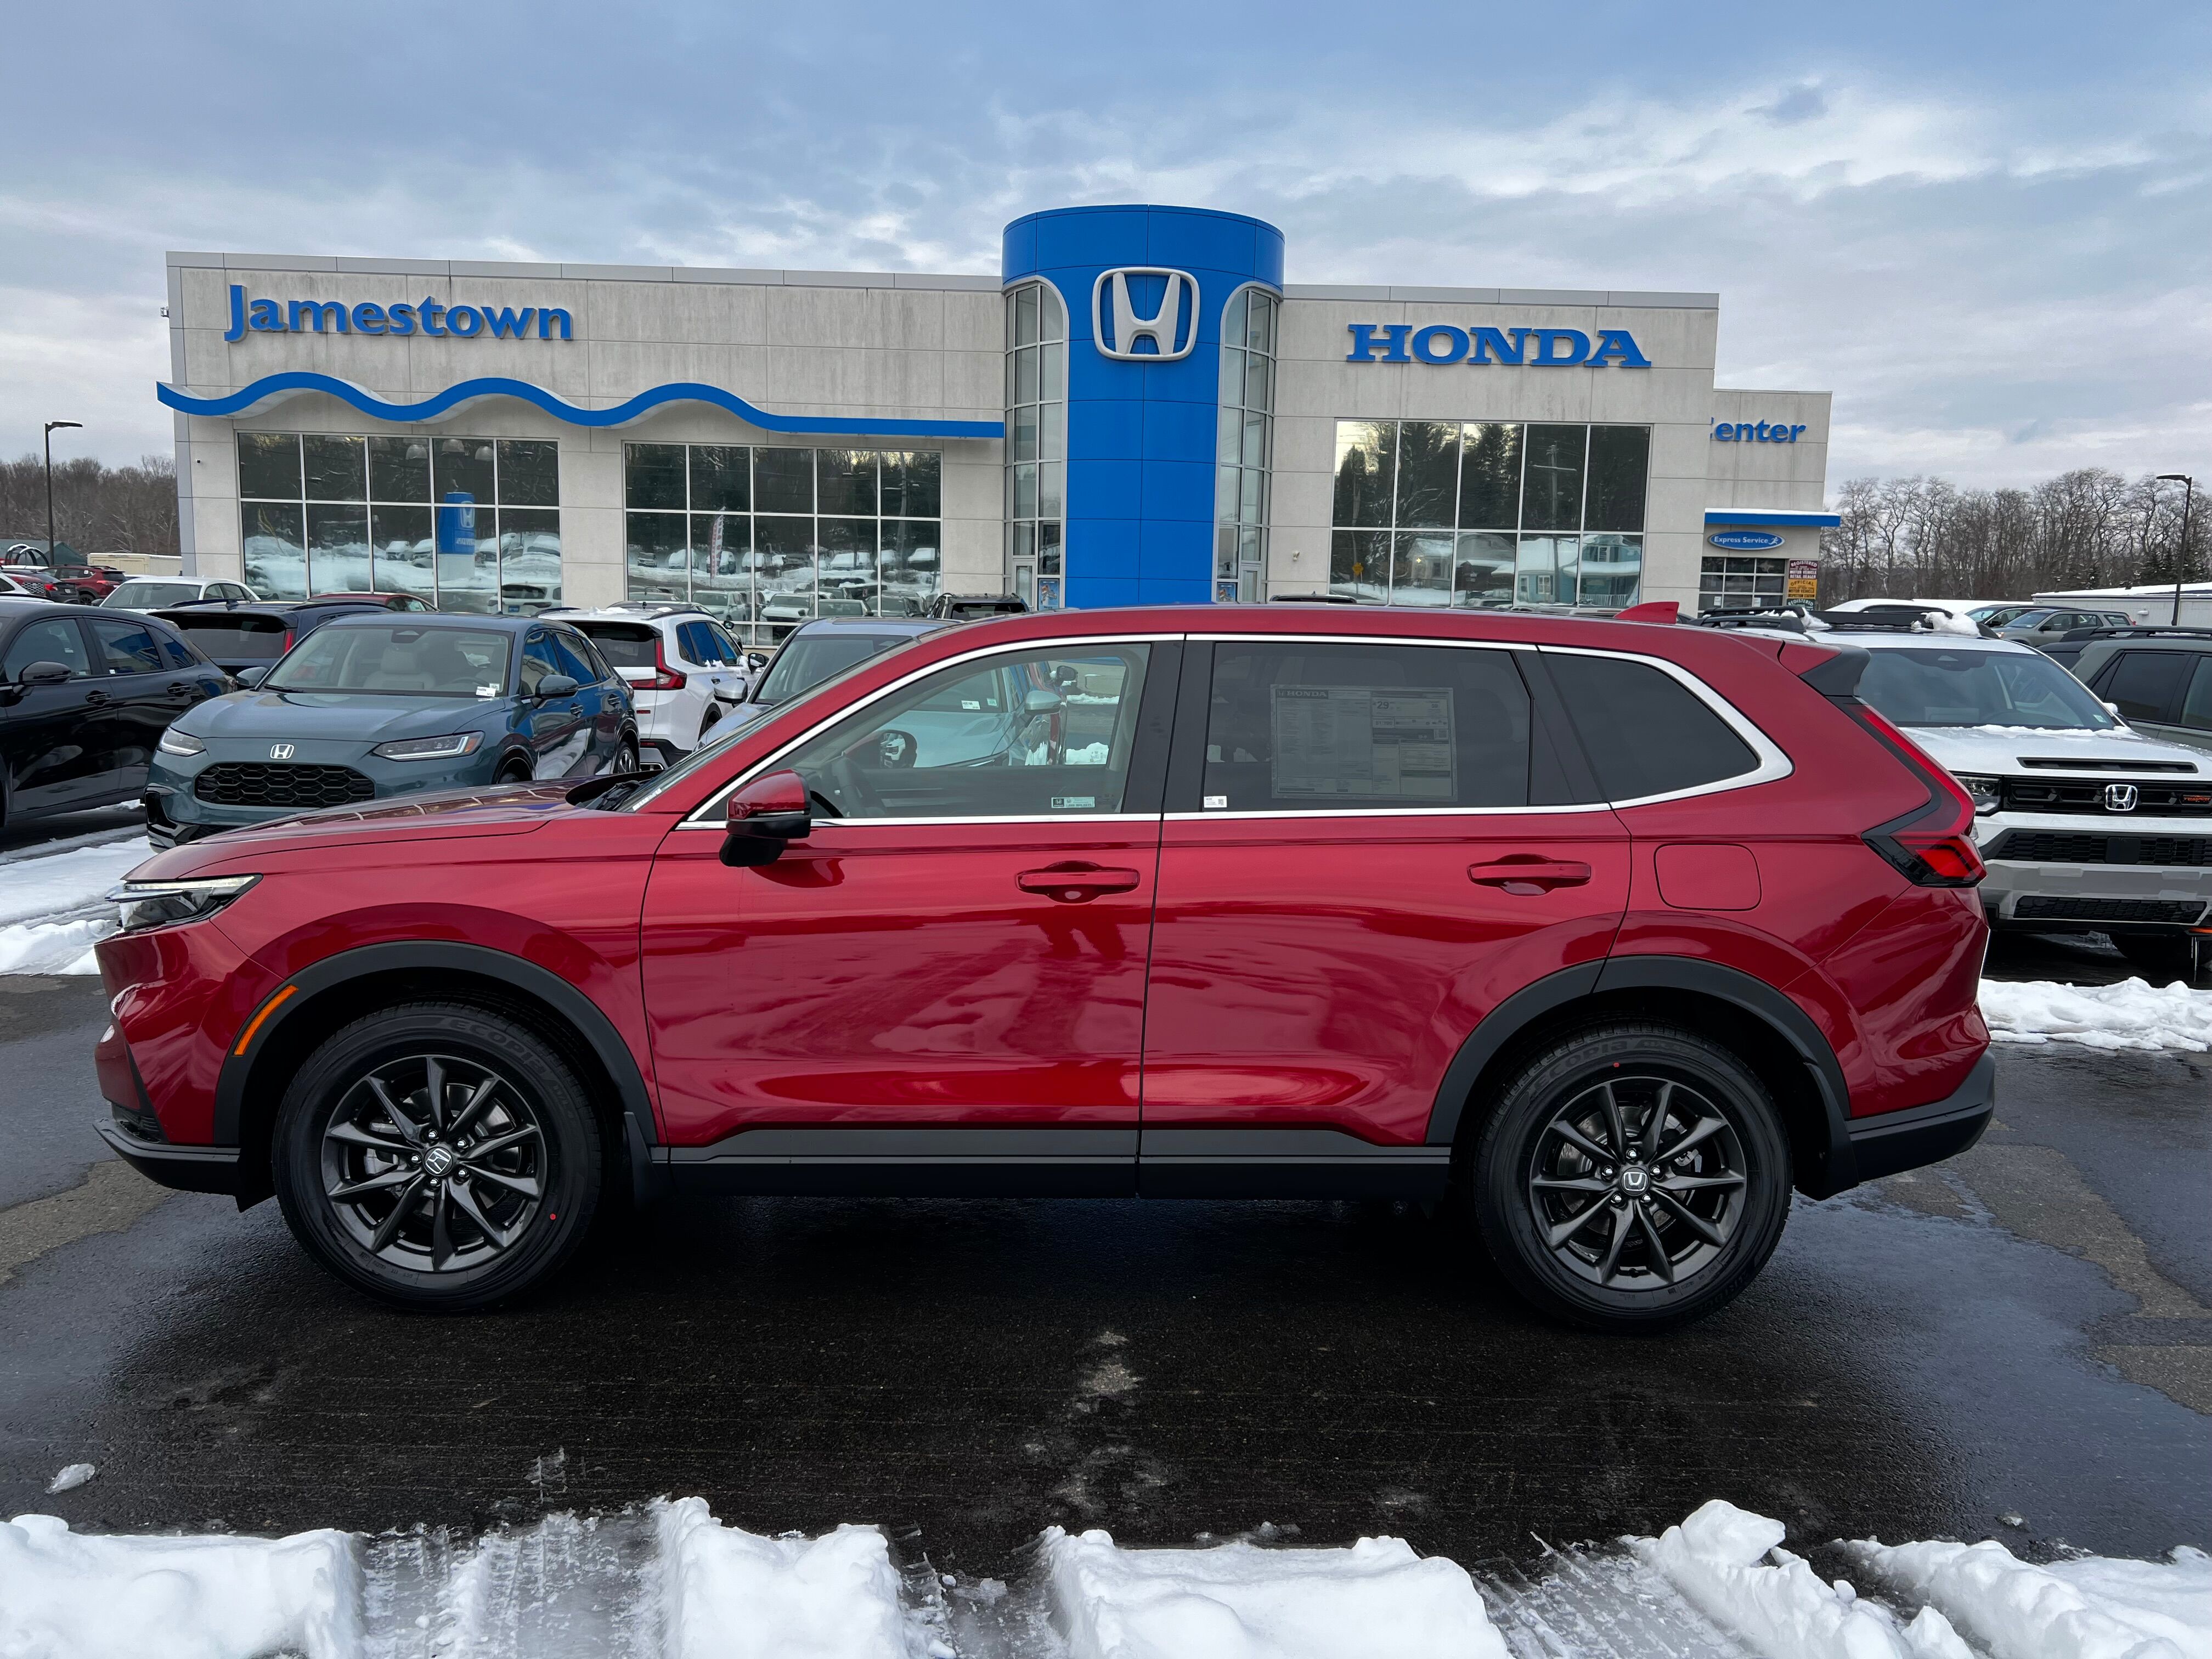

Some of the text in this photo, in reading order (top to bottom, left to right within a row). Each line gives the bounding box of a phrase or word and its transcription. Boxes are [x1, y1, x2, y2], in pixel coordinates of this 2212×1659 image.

[224, 284, 573, 343] Jamestown
[1346, 323, 1652, 368] HONDA
[1710, 417, 1807, 443] enter
[1714, 536, 1740, 544] Express
[1376, 701, 1390, 709] 29
